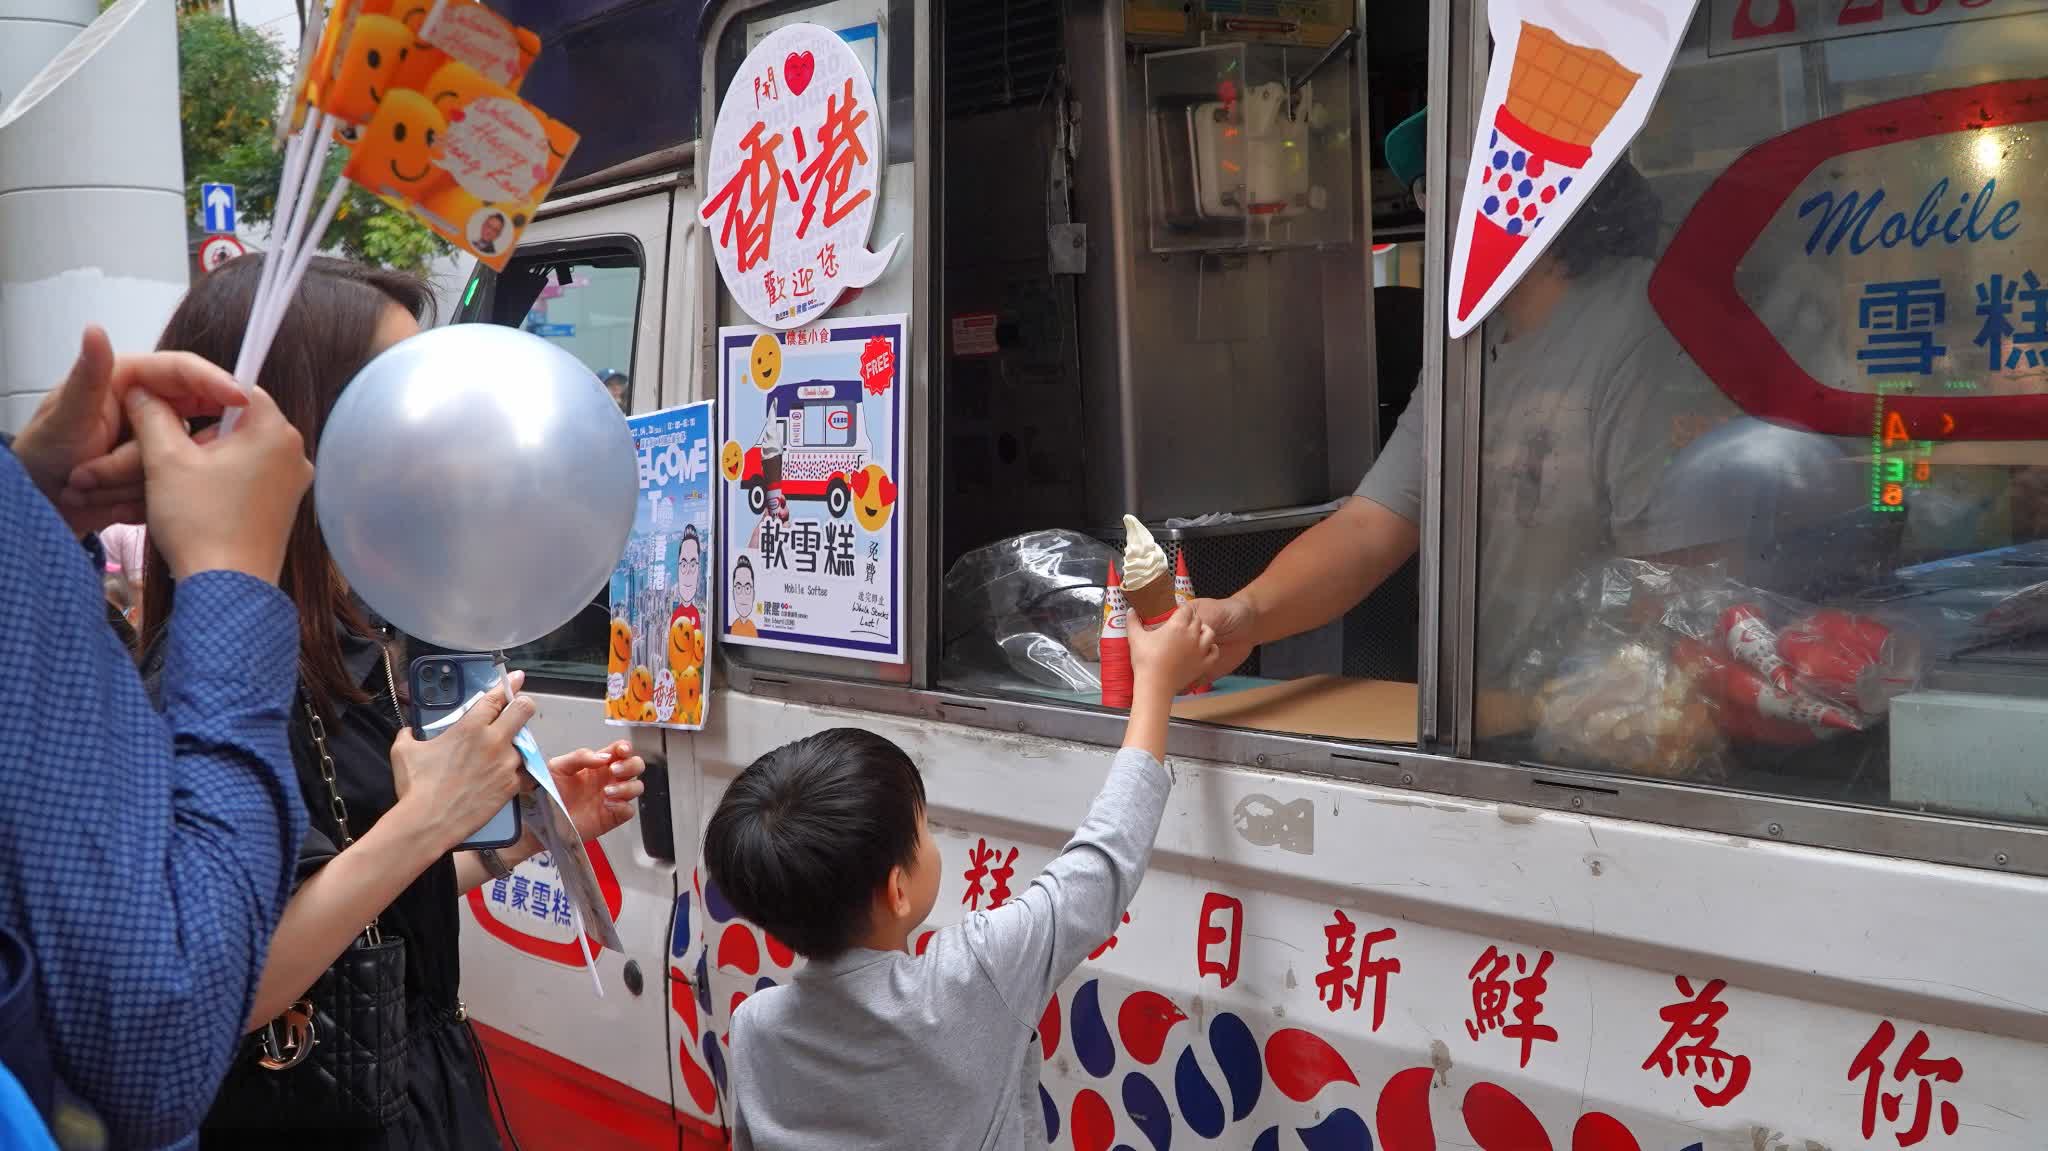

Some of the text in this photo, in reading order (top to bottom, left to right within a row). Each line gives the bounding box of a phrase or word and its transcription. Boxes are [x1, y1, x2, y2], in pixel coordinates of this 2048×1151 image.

[702, 77, 872, 273] 香港
[1798, 176, 2021, 256] Mobile
[1857, 269, 2048, 376] 雪糕
[865, 351, 890, 380] FREE
[635, 438, 708, 489] ELCOME
[761, 520, 855, 577] 軟雪糕
[864, 541, 880, 585] 免費
[784, 583, 804, 594] Mobile
